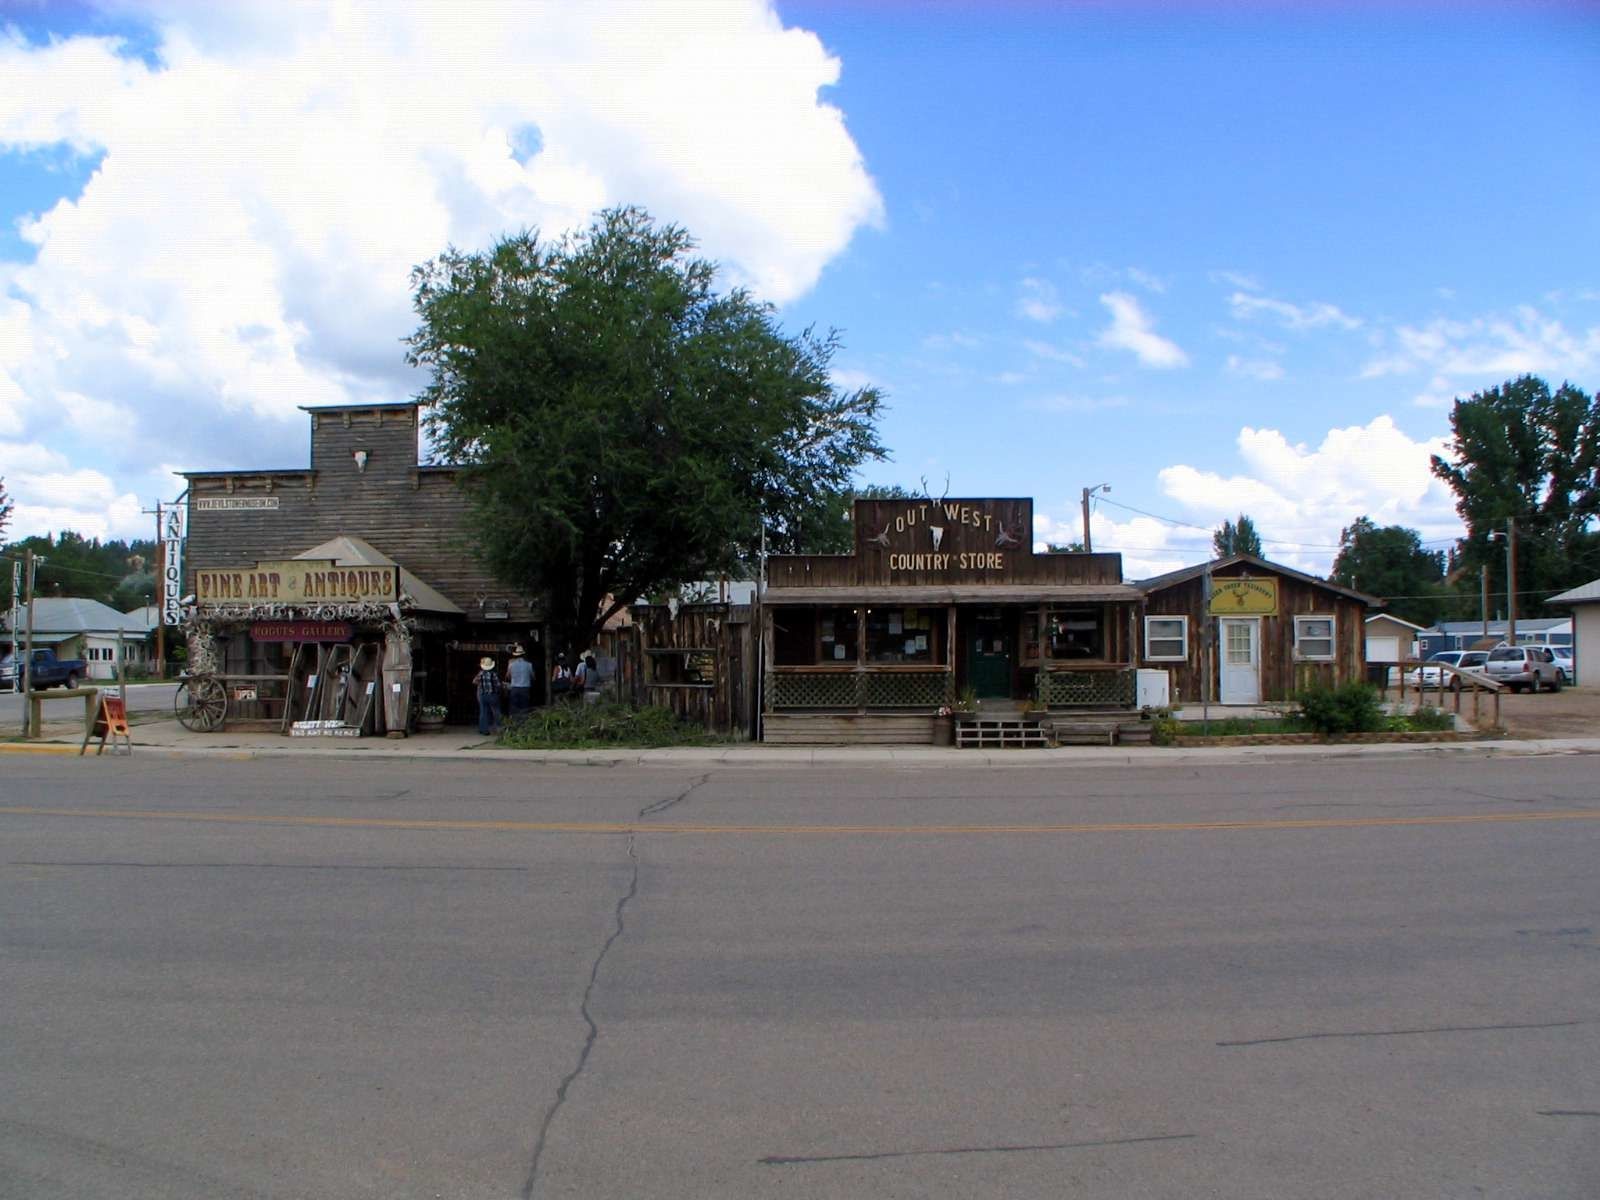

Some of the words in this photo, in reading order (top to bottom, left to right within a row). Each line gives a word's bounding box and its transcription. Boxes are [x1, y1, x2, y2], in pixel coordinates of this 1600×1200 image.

[896, 505, 928, 533] OUT
[943, 503, 992, 532] WEST
[166, 510, 180, 624] ANTIQUES
[890, 553, 950, 570] COUNTRY
[959, 552, 1003, 570] STORE
[201, 573, 243, 598] FINE
[249, 572, 280, 598] ART
[303, 570, 392, 599] ANTIQUES
[302, 626, 346, 636] GALLERY
